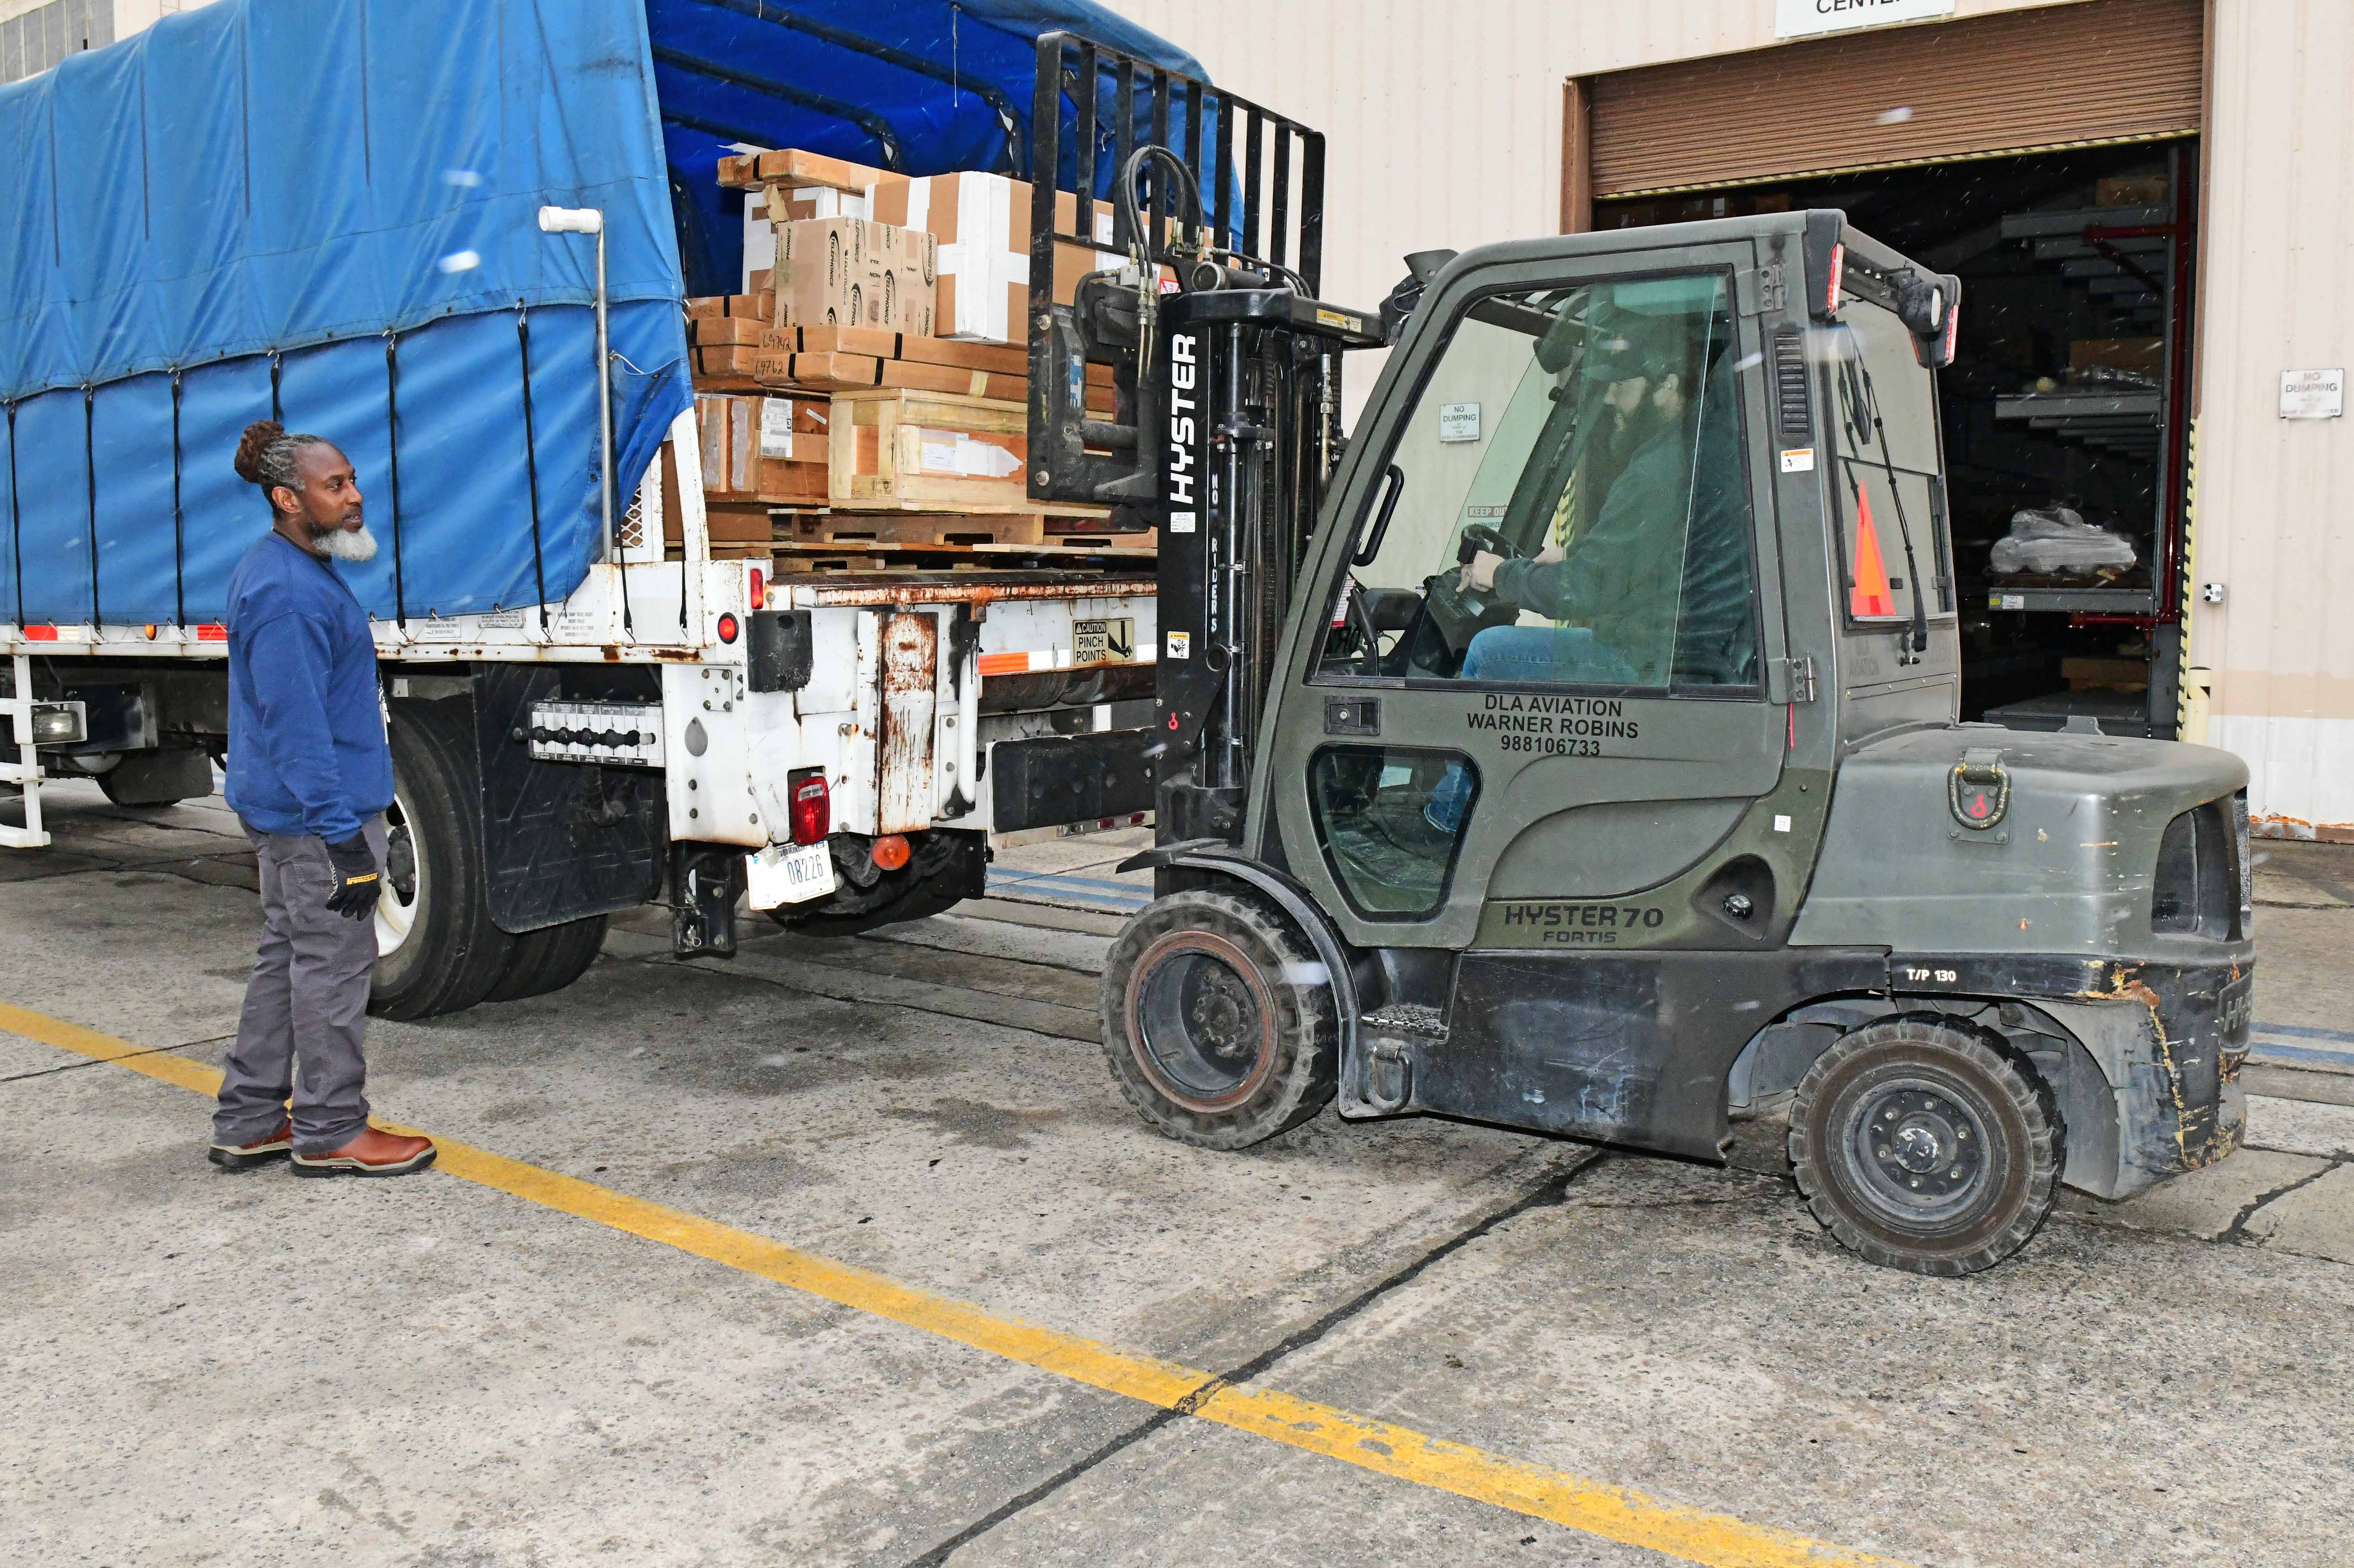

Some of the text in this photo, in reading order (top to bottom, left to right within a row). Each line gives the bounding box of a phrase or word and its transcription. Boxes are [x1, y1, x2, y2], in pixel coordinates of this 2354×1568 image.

[2286, 383, 2338, 392] DUMPING
[787, 419, 791, 428] 3
[1170, 334, 1196, 504] HYSTER
[1469, 507, 1491, 516] KEEP
[1082, 622, 1106, 633] CAUTION
[1079, 636, 1103, 648] PINCH
[1076, 649, 1106, 662] POINTS
[1485, 694, 1622, 717] DLA AVIATION
[1467, 713, 1638, 738] WARNER ROBINS
[1501, 735, 1601, 756] 988106733
[787, 854, 823, 885] 08226
[1505, 906, 1664, 928] HYSTER 70
[1543, 931, 1617, 943] FORTIS
[1907, 969, 1956, 981] T/P 130
